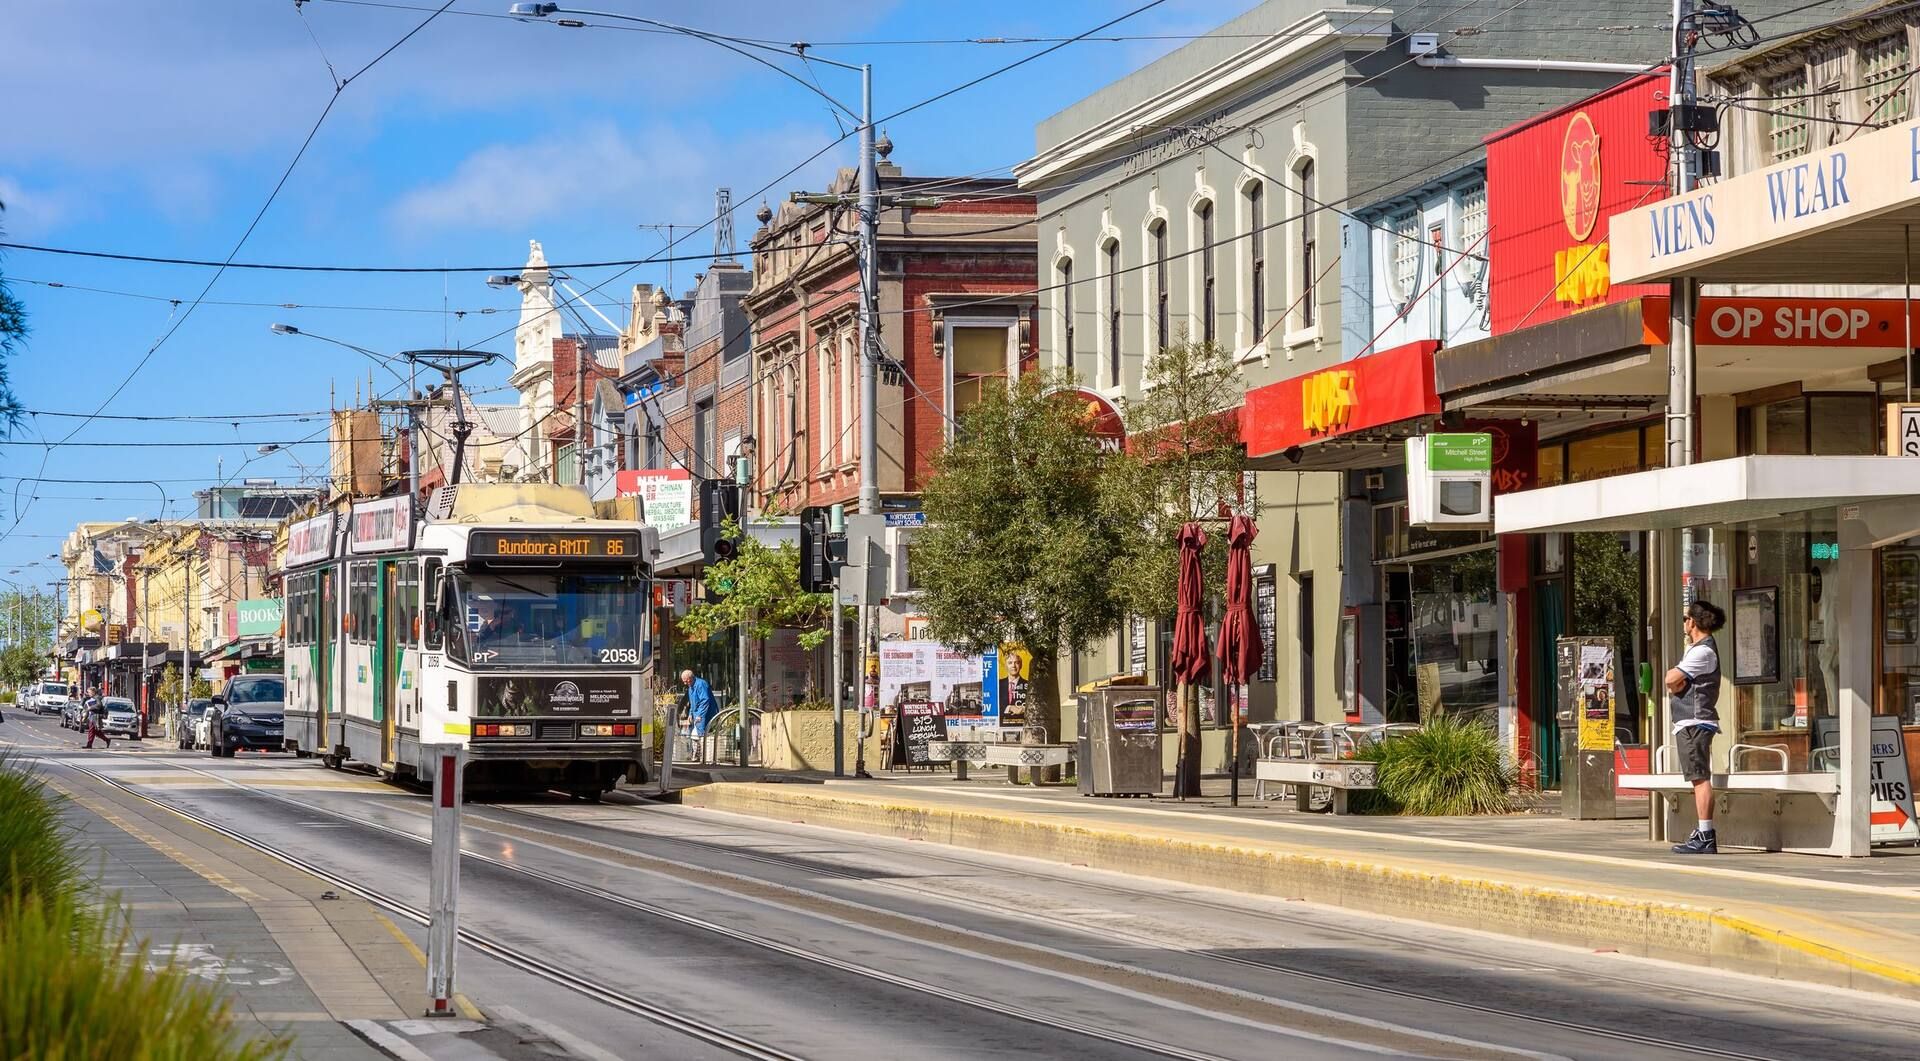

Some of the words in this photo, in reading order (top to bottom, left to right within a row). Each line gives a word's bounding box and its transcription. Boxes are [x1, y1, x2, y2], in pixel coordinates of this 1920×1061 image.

[1650, 193, 1715, 258] MENS
[1767, 152, 1850, 224] WEAR
[1711, 306, 1763, 339] OP
[1774, 306, 1870, 340] SHOP
[1469, 448, 1487, 456] Street
[498, 539, 557, 555] Bundoora
[560, 540, 590, 555] RMIT
[607, 540, 624, 555] 86
[428, 656, 440, 668] 2058
[601, 649, 638, 663] 2058
[913, 715, 933, 725] $15
[912, 724, 936, 733] LUNCH
